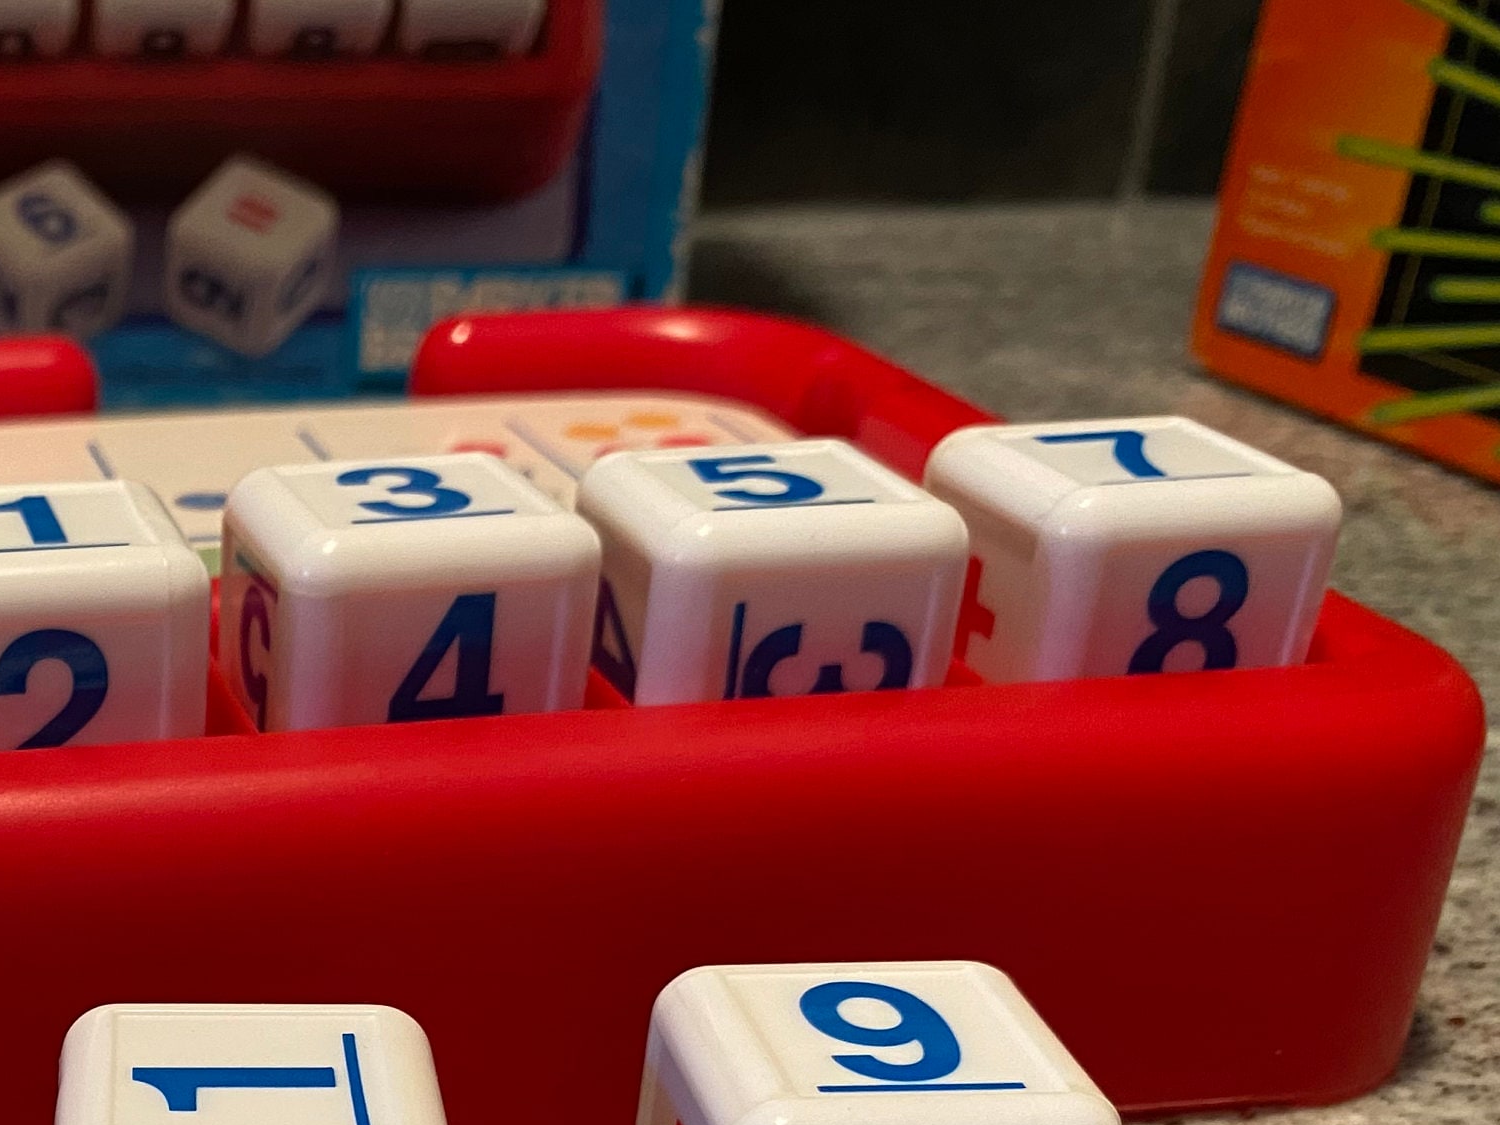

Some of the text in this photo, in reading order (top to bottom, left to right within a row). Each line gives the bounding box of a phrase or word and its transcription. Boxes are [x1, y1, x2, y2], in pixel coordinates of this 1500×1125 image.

[1033, 430, 1167, 478] 7
[336, 466, 473, 517] 3
[687, 455, 825, 504] 5
[387, 592, 504, 723] 4
[799, 981, 961, 1082] 9
[132, 1067, 336, 1111] 1
